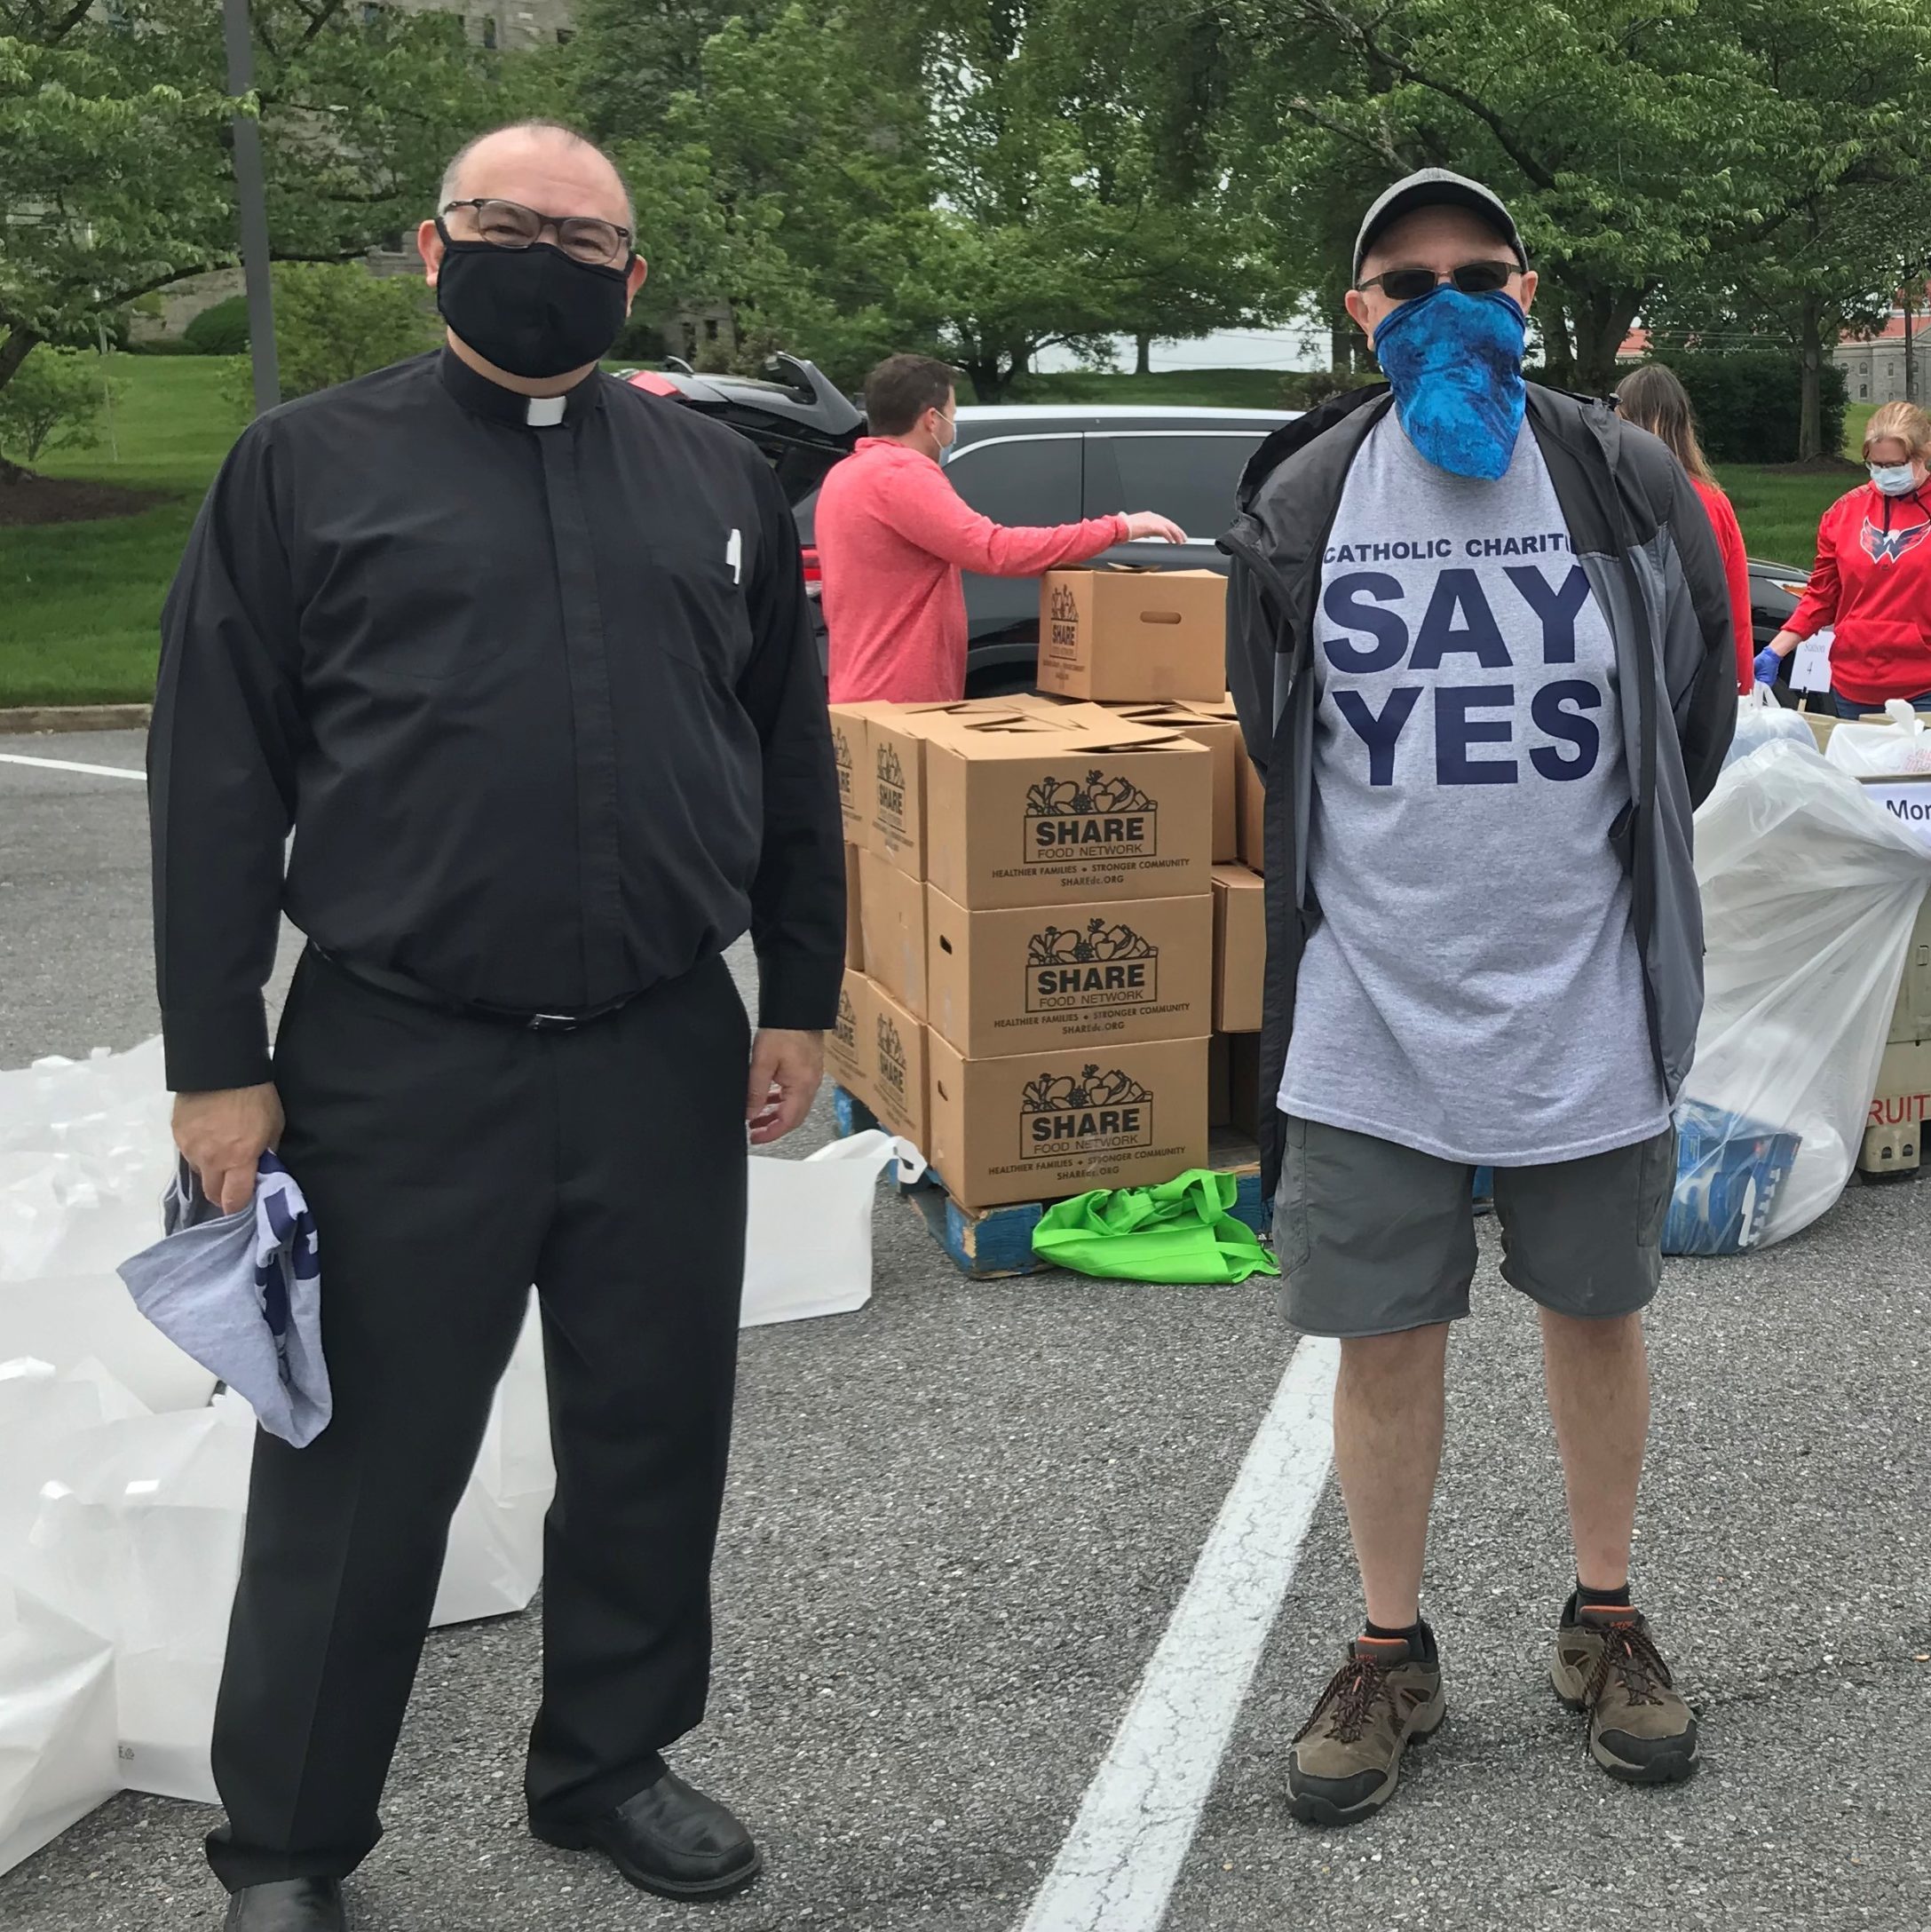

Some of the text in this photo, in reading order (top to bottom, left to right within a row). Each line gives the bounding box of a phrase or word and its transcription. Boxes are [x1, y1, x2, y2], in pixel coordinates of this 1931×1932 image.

[1323, 539, 1452, 564] CATHOLIC
[1322, 565, 1592, 674] SAY
[1332, 679, 1602, 787] YES
[1036, 817, 1144, 846] SHARE
[1038, 843, 1144, 859] FOOD NETWORK
[992, 859, 1190, 878] HEALTHIER FAMILIES STRONGER COMMUNITY
[1037, 963, 1145, 995] SHARE
[1039, 989, 1144, 1008] FOOD NETWORK
[993, 1002, 1191, 1028] HEALTHIER FAMILIES STRONGER COMMUNITY
[1032, 1108, 1140, 1142] SHARE
[1033, 1135, 1139, 1154] FOOD NETWORK
[988, 1163, 1033, 1176] HEALTHIER
[1035, 1159, 1073, 1171] FAMILIES
[1135, 1146, 1186, 1160] COMMUNITY
